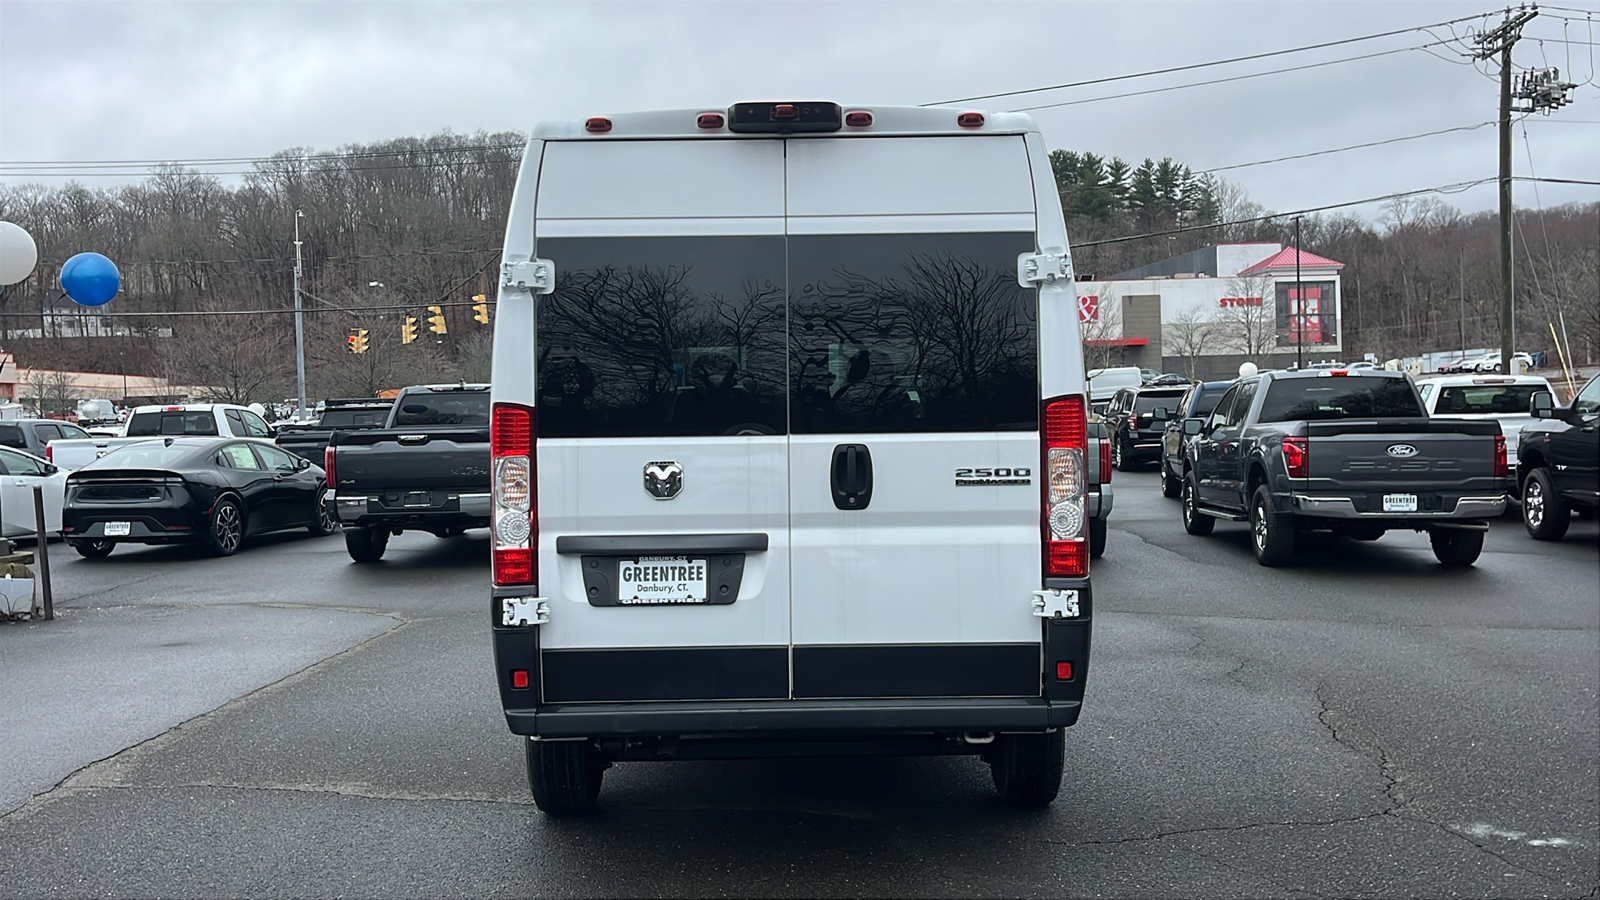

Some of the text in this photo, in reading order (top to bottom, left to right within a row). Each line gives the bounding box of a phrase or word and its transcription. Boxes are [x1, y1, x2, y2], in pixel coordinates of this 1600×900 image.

[955, 468, 1031, 478] 2500
[623, 566, 703, 582] GREENTREE
[637, 584, 675, 593] Danbury,
